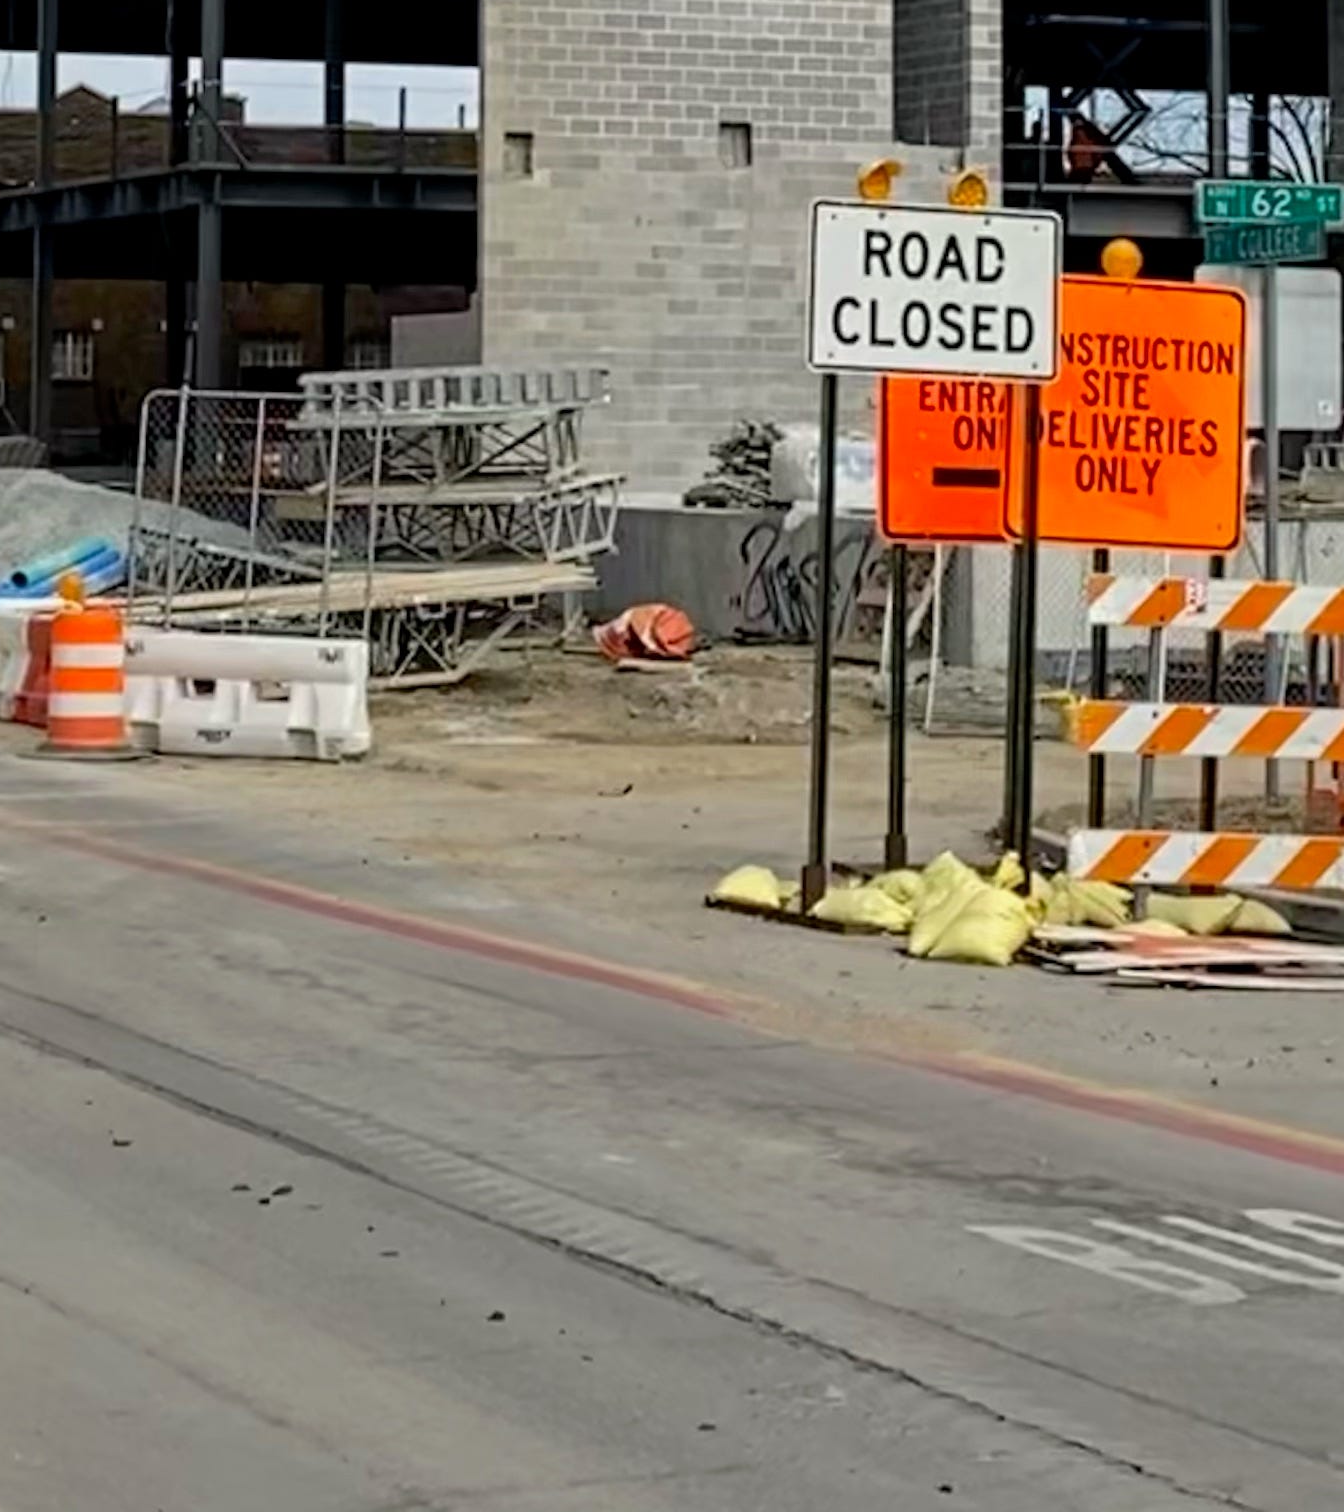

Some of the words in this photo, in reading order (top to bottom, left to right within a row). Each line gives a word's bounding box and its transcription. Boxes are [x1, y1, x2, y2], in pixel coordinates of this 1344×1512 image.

[864, 229, 1004, 283] ROAD
[832, 296, 1035, 354] CLOSED
[1080, 369, 1151, 410] SITE
[953, 416, 1005, 451] ON
[1074, 453, 1162, 497] ONLY
